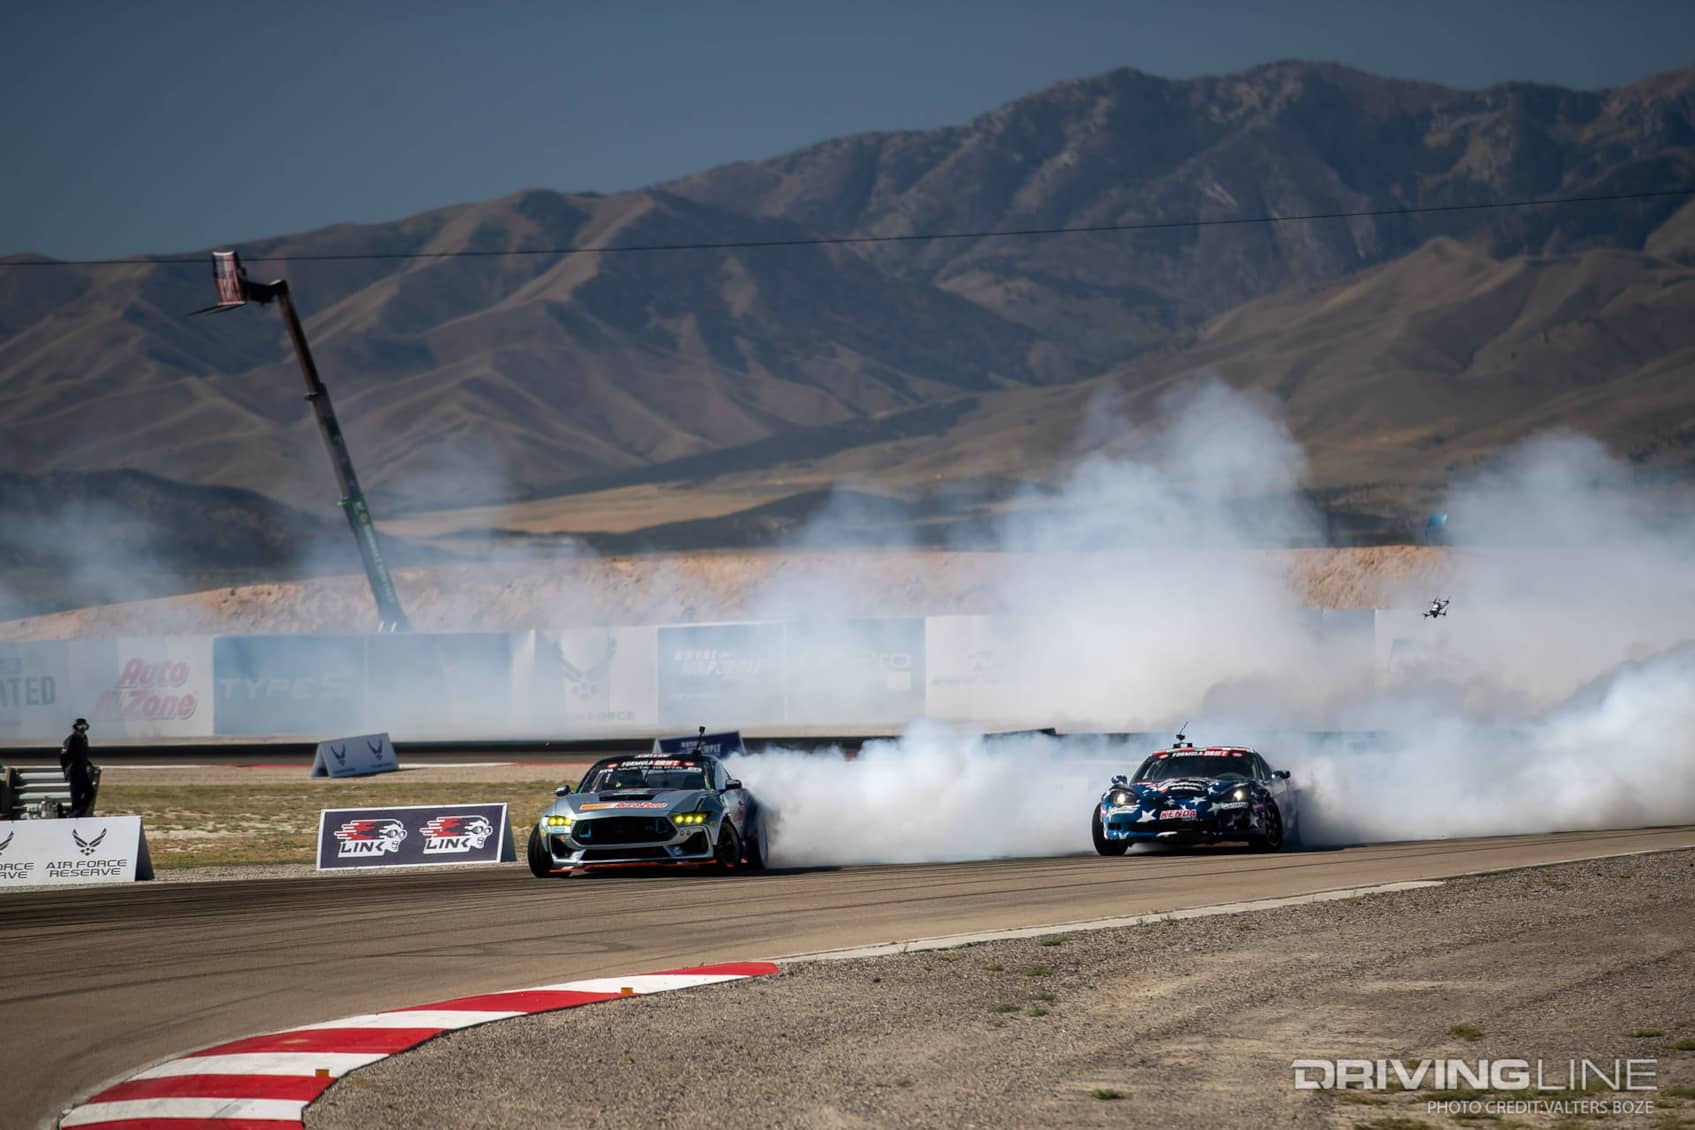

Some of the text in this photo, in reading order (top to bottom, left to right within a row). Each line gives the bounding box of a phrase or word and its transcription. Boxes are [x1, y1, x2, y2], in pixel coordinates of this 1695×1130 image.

[118, 658, 189, 688] Auto
[1160, 809, 1197, 819] KENDA
[340, 841, 385, 853] LINK
[426, 838, 470, 850] LINK
[46, 859, 128, 870] AIR FORCE
[49, 868, 121, 878] RESERVE
